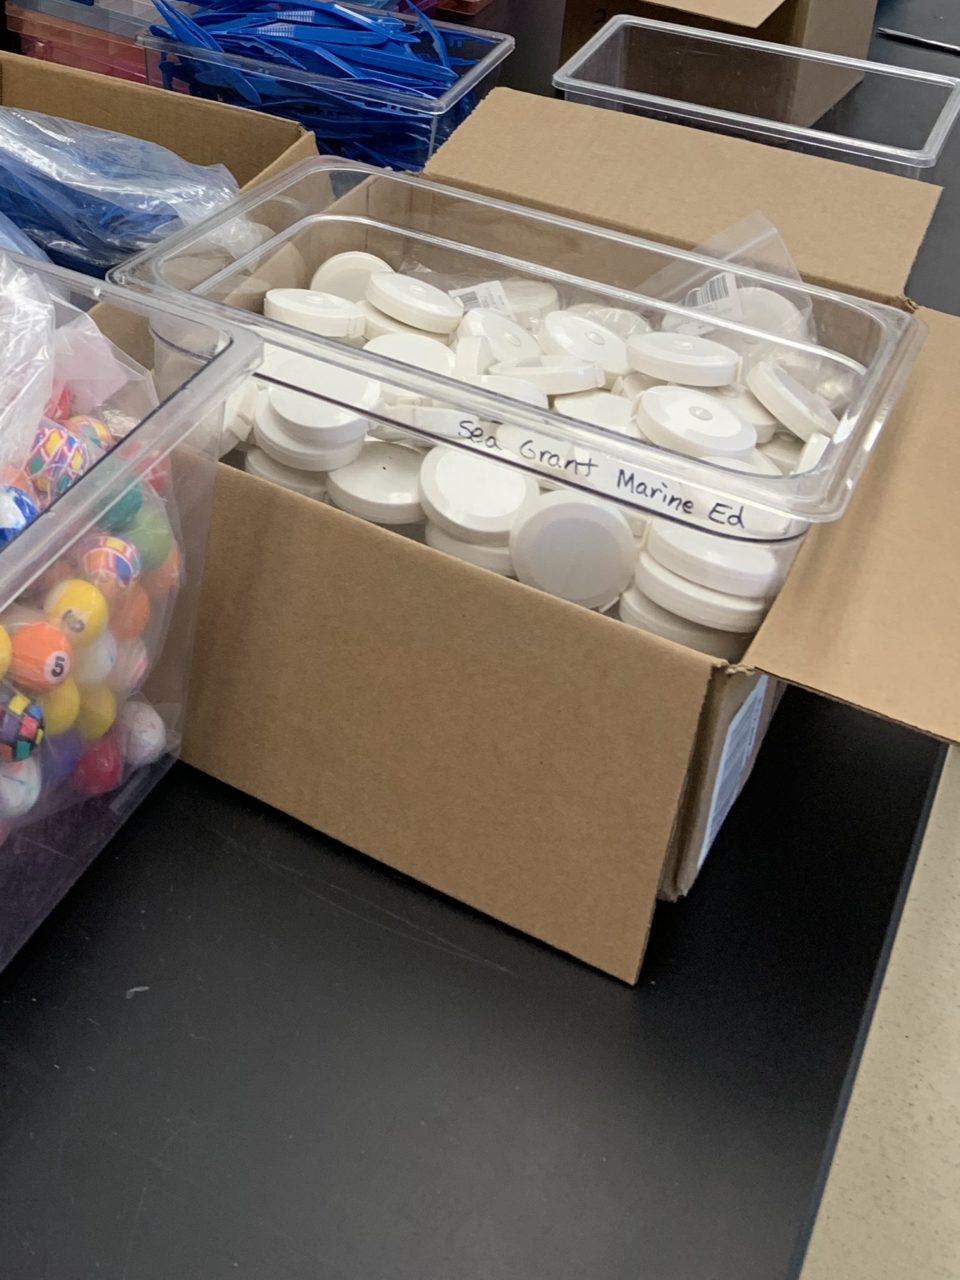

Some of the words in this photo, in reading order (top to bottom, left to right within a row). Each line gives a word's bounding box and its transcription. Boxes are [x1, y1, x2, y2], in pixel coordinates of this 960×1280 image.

[458, 420, 502, 451] Sea
[519, 439, 599, 477] Grant
[616, 468, 694, 514] Marine
[708, 501, 746, 529] Ed
[51, 656, 66, 678] 5
